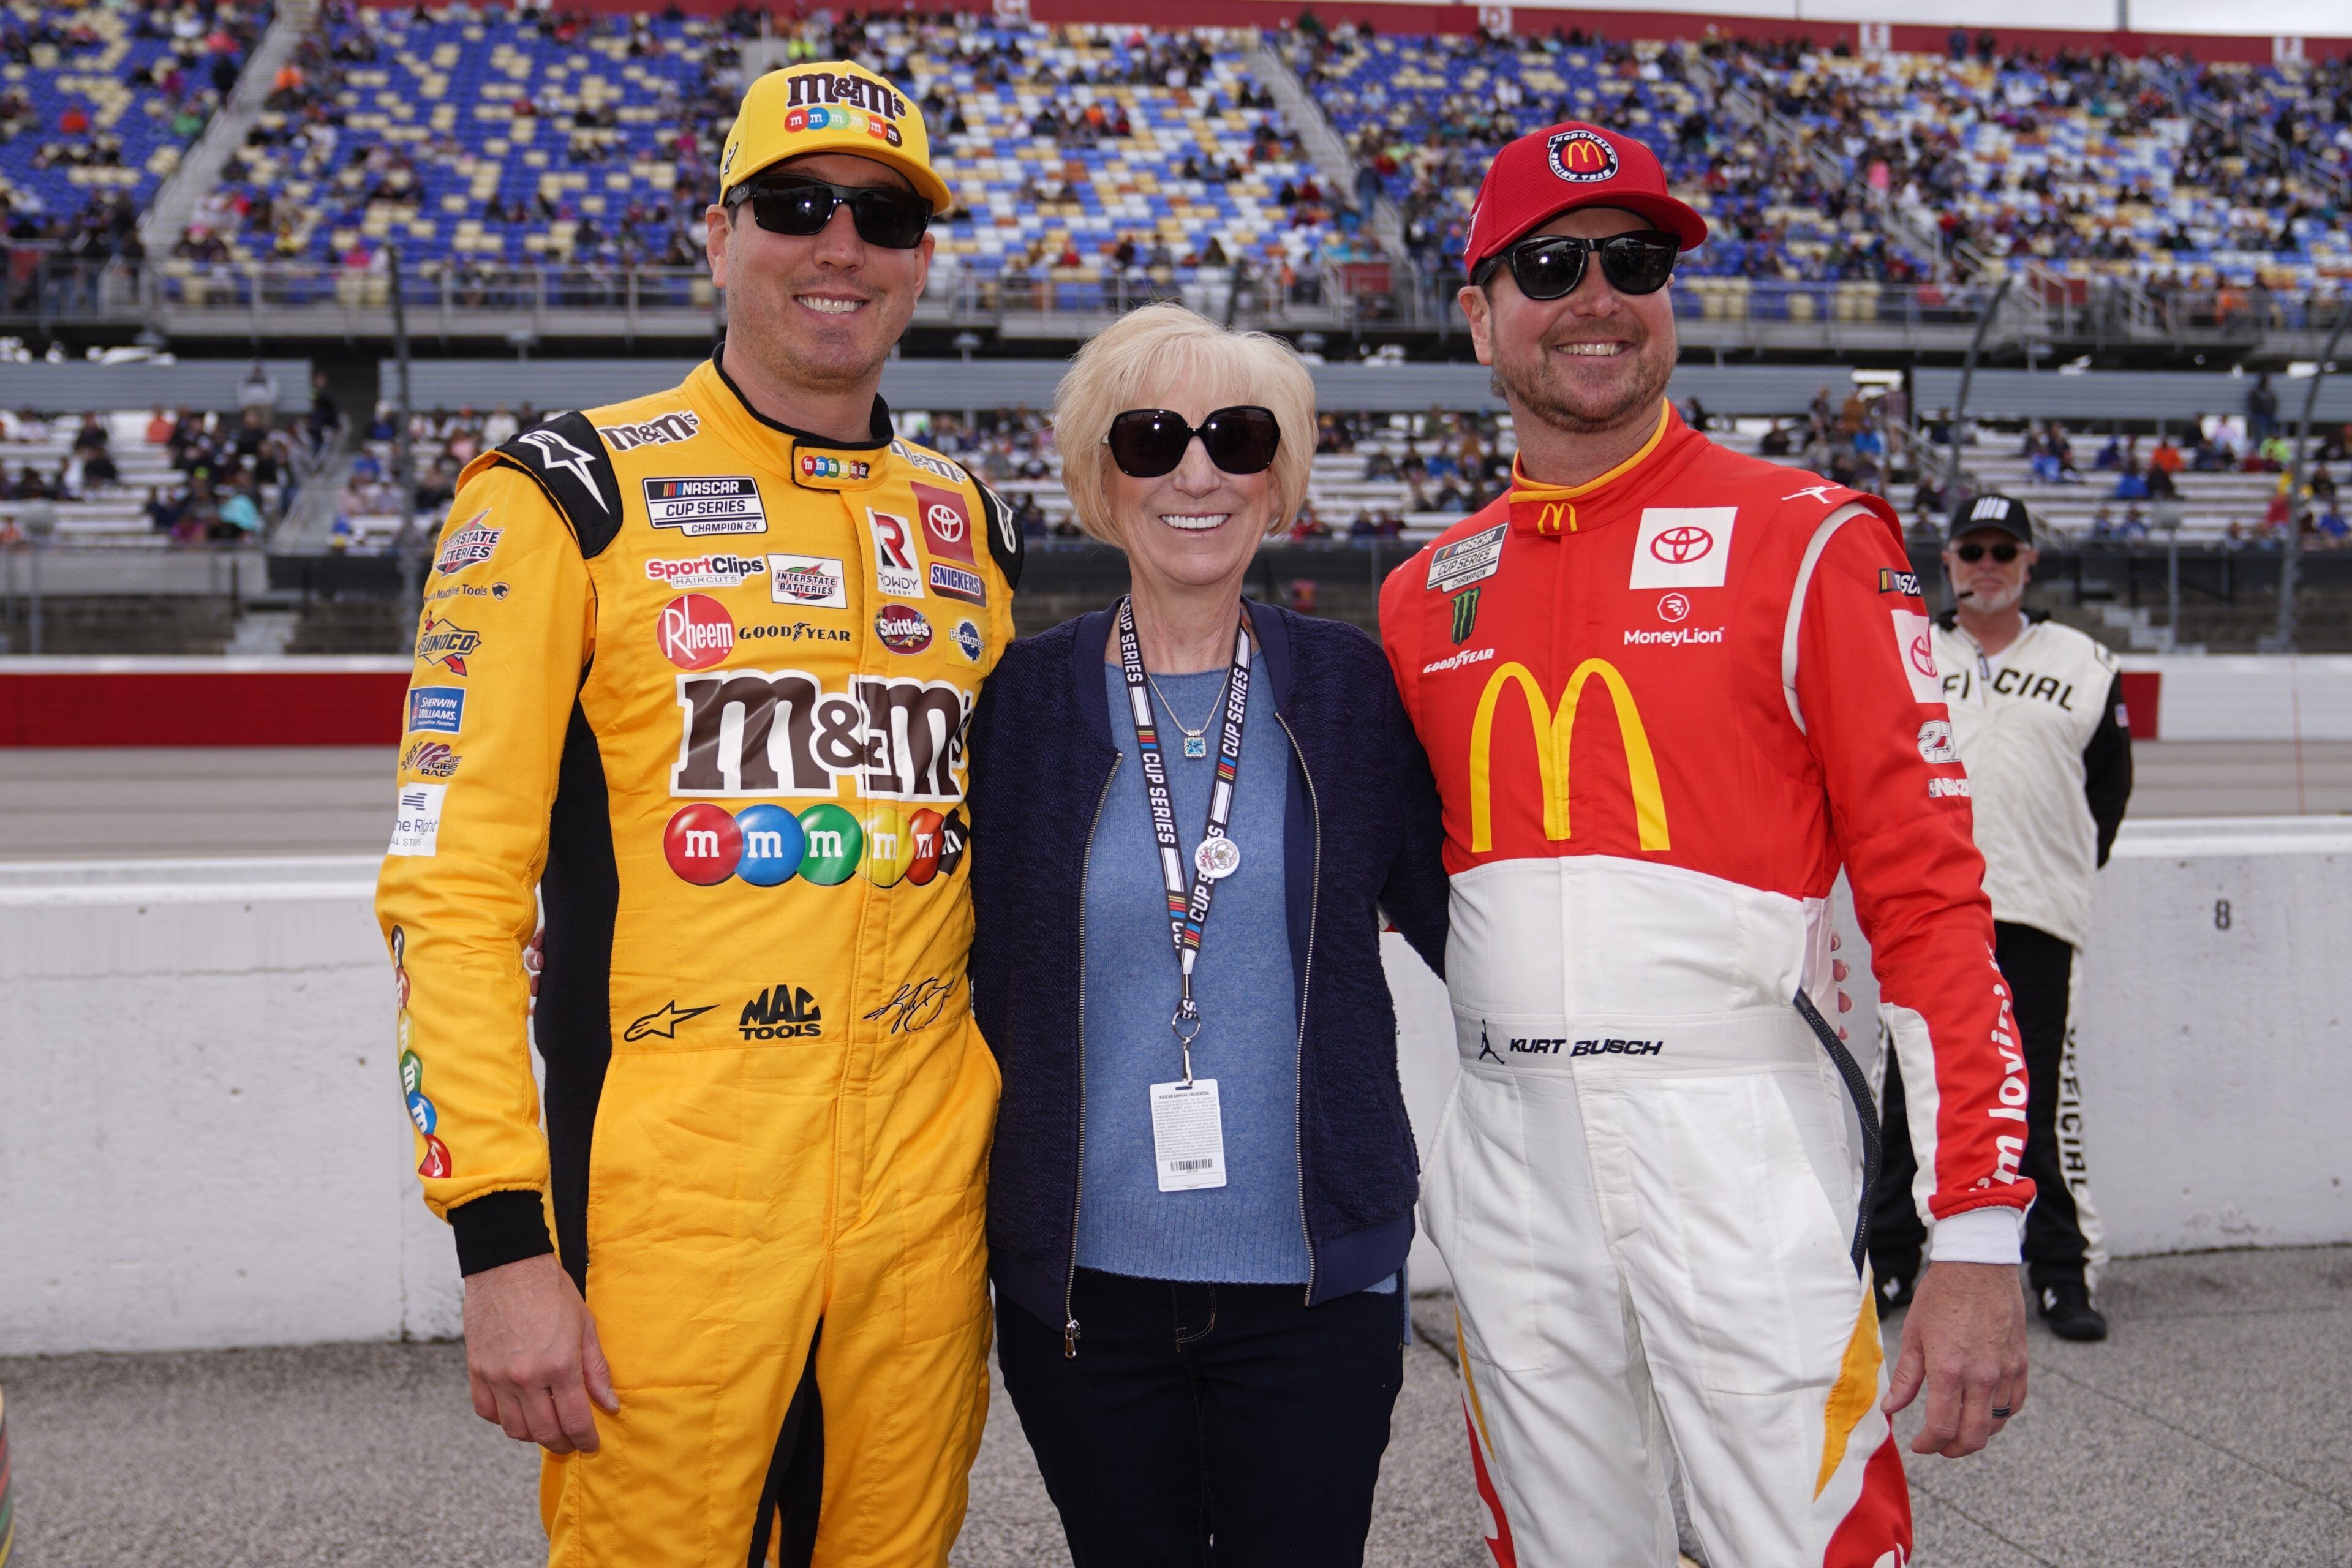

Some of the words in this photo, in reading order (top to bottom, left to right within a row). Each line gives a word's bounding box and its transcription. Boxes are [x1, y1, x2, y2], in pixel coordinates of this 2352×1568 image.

[790, 114, 803, 126] m
[809, 113, 824, 124] m
[829, 113, 844, 124] m
[851, 115, 865, 127] m
[870, 121, 883, 134] m
[887, 129, 899, 142] m
[682, 481, 740, 496] NASCAR
[666, 503, 695, 516] CUP
[697, 500, 746, 514] SERIES
[692, 522, 743, 533] CHAMPION
[745, 521, 758, 530] 2X
[1454, 530, 1497, 555] NASCAR
[648, 557, 764, 579] SportClips
[1438, 559, 1457, 576] CUP
[1457, 548, 1491, 570] SERIES
[676, 576, 737, 585] HAIRCUTS
[777, 571, 837, 586] INTERSTATE
[779, 582, 834, 595] BATTERIES
[932, 565, 980, 595] SNICKERS
[1452, 567, 1487, 587] CHAMPION
[462, 584, 488, 596] Tools
[665, 595, 733, 660] Rheem
[879, 617, 930, 638] Skittles
[1120, 604, 1133, 631] CUP
[420, 633, 476, 654] SUNOCO
[739, 623, 851, 642] GOODYEAR
[949, 628, 985, 651] Pedigree
[1624, 627, 1722, 647] MoneyLion
[1121, 633, 1144, 683] SERIES
[1423, 648, 1494, 673] GOODYEAR
[1227, 668, 1249, 724] SERIES
[1943, 668, 2075, 711] FICIAL
[420, 696, 458, 709] SHERWIN
[1222, 723, 1241, 758] CUP
[1142, 753, 1164, 784] CUP
[1149, 786, 1175, 845] SERIES
[1189, 882, 1211, 923] CUP
[2215, 899, 2231, 930] 8
[739, 984, 821, 1026] MAC
[739, 1025, 822, 1041] TOOLS
[1509, 1038, 1567, 1054] KURT
[1570, 1038, 1664, 1057] BUSCH
